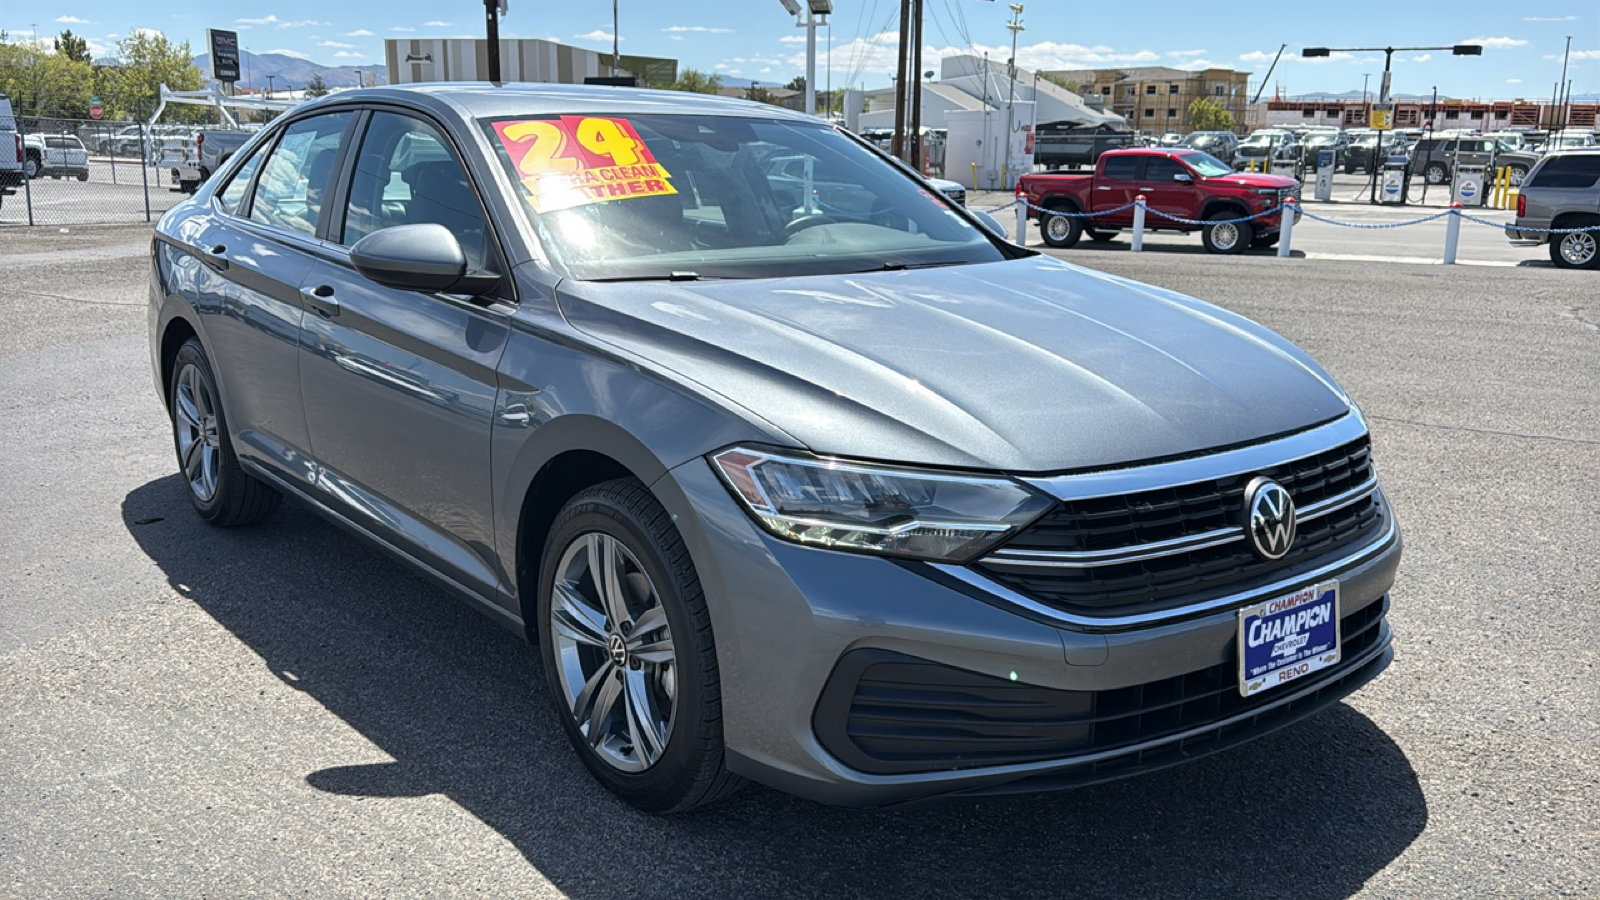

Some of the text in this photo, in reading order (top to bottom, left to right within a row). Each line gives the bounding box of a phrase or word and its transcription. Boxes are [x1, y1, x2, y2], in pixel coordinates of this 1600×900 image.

[215, 36, 236, 46] GMC
[502, 117, 645, 175] 24
[599, 164, 660, 181] CLEAN
[1251, 483, 1295, 558] VW
[1269, 589, 1315, 614] CHAMPION
[1249, 602, 1331, 647] CHAMPION
[1274, 635, 1307, 652] CHEVROLET
[1279, 663, 1309, 681] RENO
